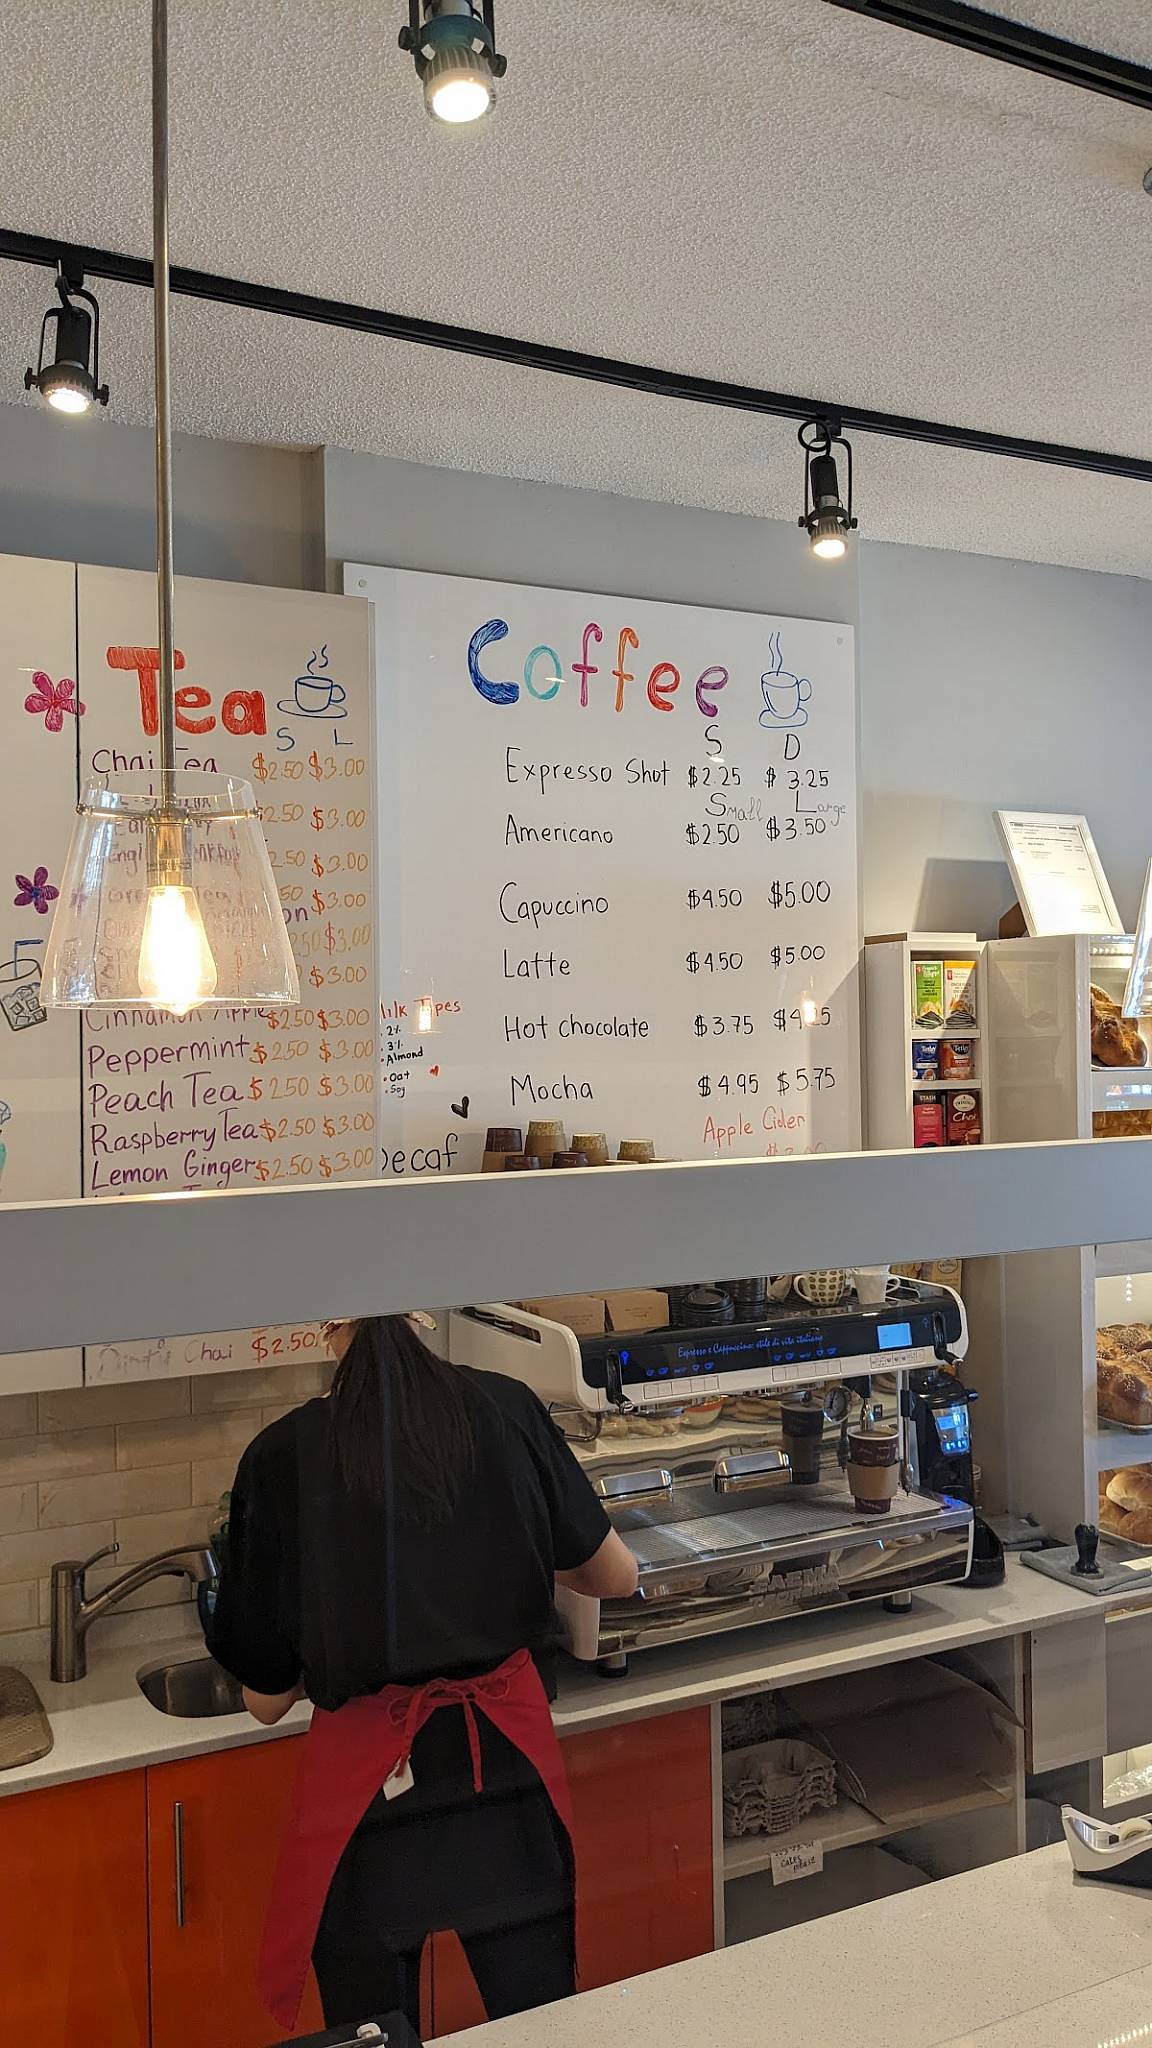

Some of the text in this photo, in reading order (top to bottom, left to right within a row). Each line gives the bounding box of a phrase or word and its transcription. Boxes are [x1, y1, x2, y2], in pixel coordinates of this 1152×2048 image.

[467, 618, 729, 717] Coffee
[106, 646, 267, 737] Tea
[277, 727, 353, 751] S L
[704, 724, 801, 760] S D
[252, 751, 304, 785] $2.50
[309, 750, 365, 782] $3.00
[506, 746, 612, 794] Expresso
[625, 757, 671, 786] Shot
[687, 765, 741, 789] $2.25
[311, 805, 366, 832] $3.00
[705, 790, 846, 827] Small Large
[505, 813, 827, 846] Americano $2.50 $3.50
[267, 849, 305, 869] 2.50
[311, 853, 369, 878] $3.00
[311, 889, 366, 916] $3.00
[499, 880, 831, 929] Capuccino $4.50 $5.00
[309, 965, 367, 989] $3.00
[503, 945, 825, 979] Latte $4.50 $5.00
[267, 1009, 314, 1030] $2.50
[317, 1008, 370, 1031] $3.00
[413, 997, 461, 1017] Tpes
[504, 1014, 548, 1042] Hot
[694, 1014, 754, 1037] $3.75
[88, 1034, 250, 1079] Peppermint
[249, 1040, 309, 1064] $2.50
[386, 1045, 424, 1067] Almond
[389, 1070, 410, 1082] Oat
[511, 1067, 836, 1107] Mocha $4.95 $5.75
[88, 1071, 374, 1118] Peach Tea $2.50 $3.00
[90, 1107, 375, 1155] Raspberry Tea $2.50 $3.00
[703, 1105, 806, 1148] Apple Cider
[92, 1160, 168, 1190] Lemon
[184, 1149, 256, 1189] Ginger
[254, 1154, 313, 1181] $2.50
[319, 1148, 374, 1177] $3.00
[252, 1332, 316, 1363] $2.50
